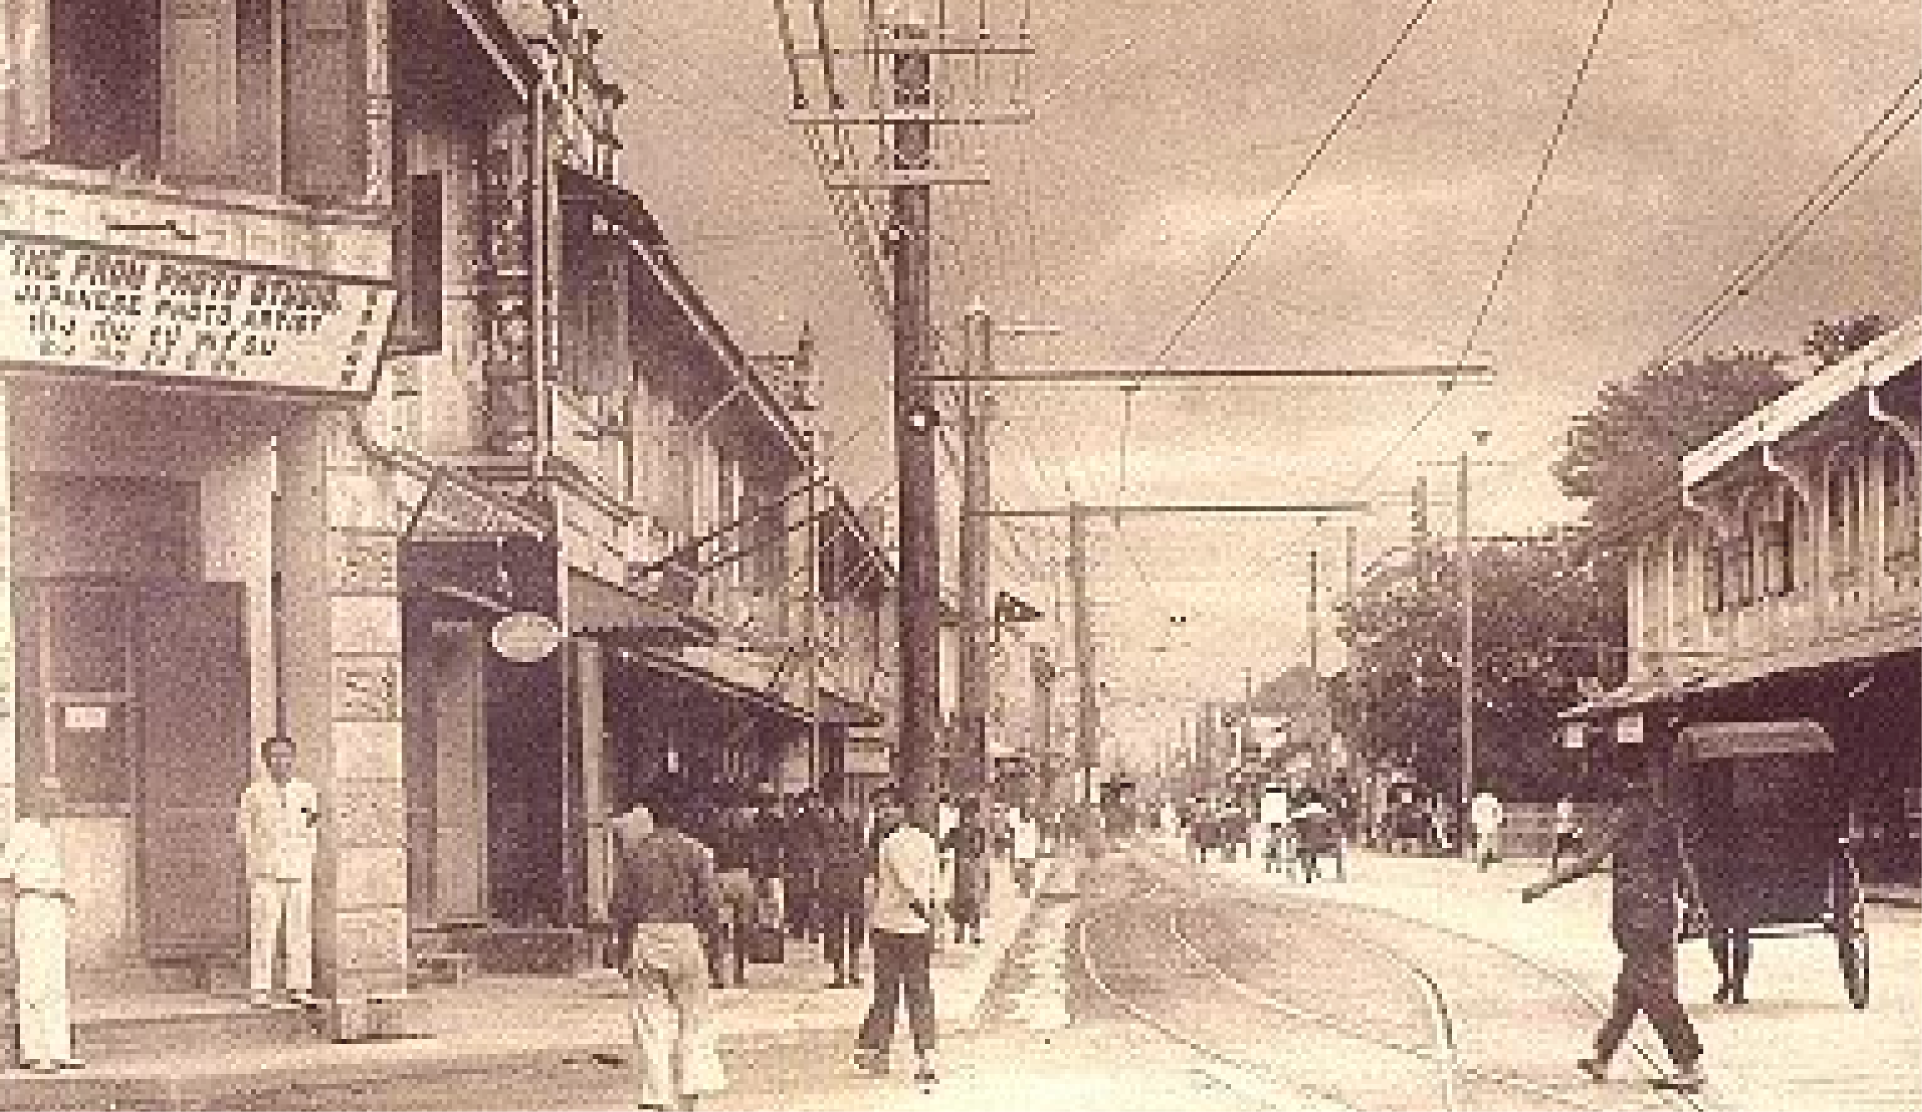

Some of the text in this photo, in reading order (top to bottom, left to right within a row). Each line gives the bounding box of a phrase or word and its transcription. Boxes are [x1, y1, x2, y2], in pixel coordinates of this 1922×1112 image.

[10, 245, 60, 280] THE
[155, 263, 241, 299] PHOTO
[14, 285, 141, 317] JAPANESE
[155, 298, 231, 327] PHOTO
[241, 306, 321, 335] ARTIST
